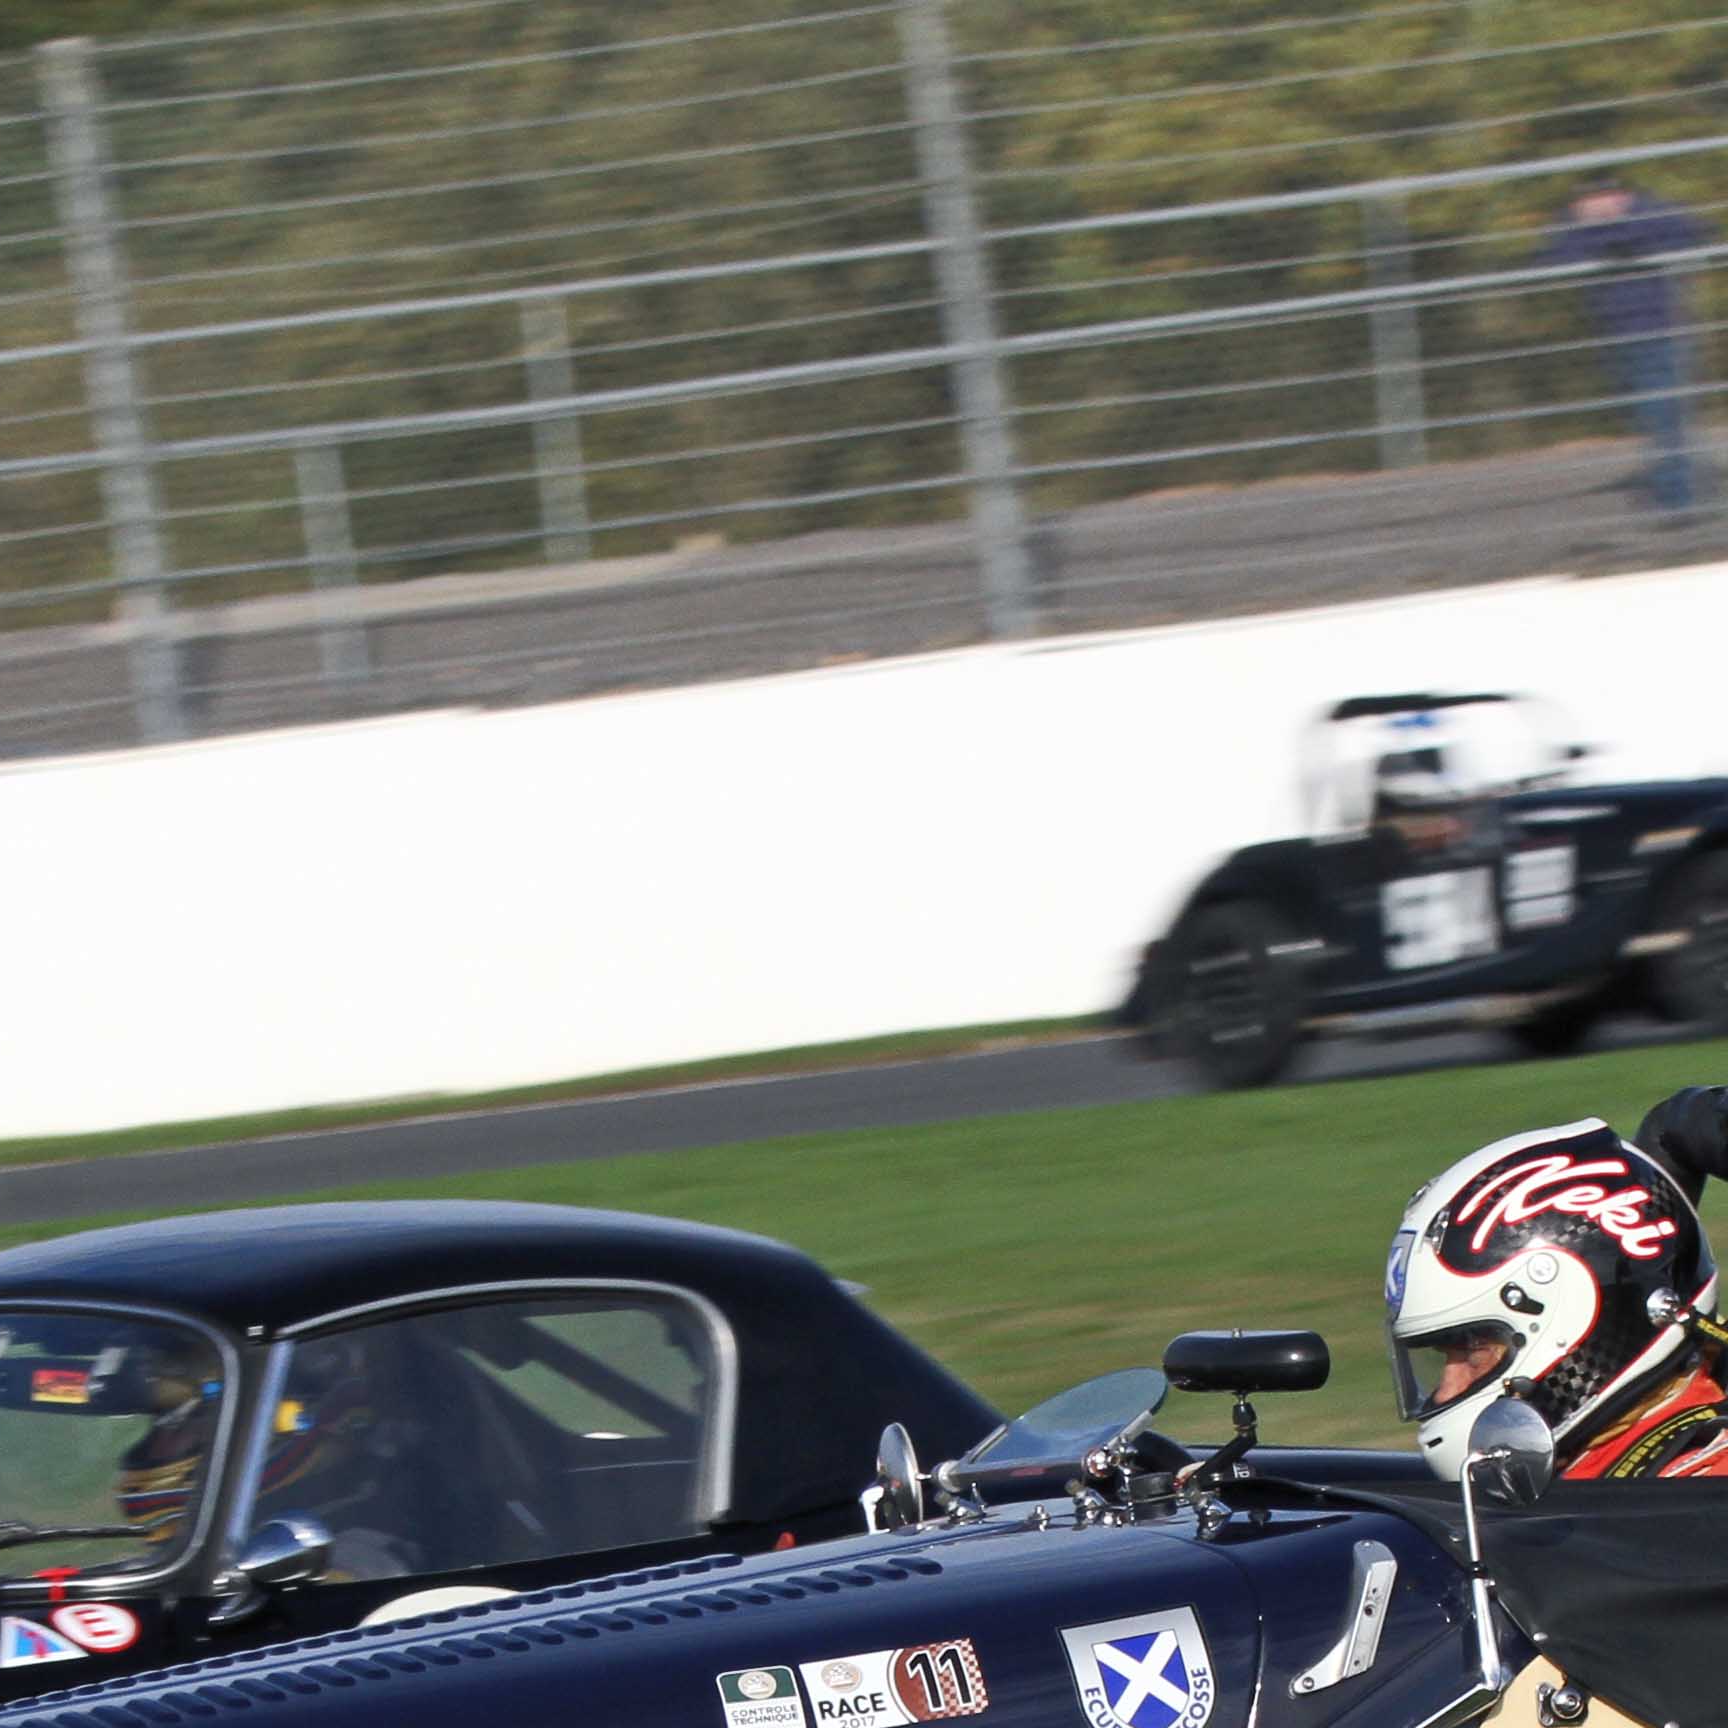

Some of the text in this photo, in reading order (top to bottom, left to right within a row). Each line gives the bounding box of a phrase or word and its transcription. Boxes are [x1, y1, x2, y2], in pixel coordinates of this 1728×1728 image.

[906, 1645, 976, 1711] 11
[731, 1704, 798, 1719] CONTROLE
[818, 1692, 887, 1720] RACE
[733, 1711, 800, 1726] TECHNIQUE
